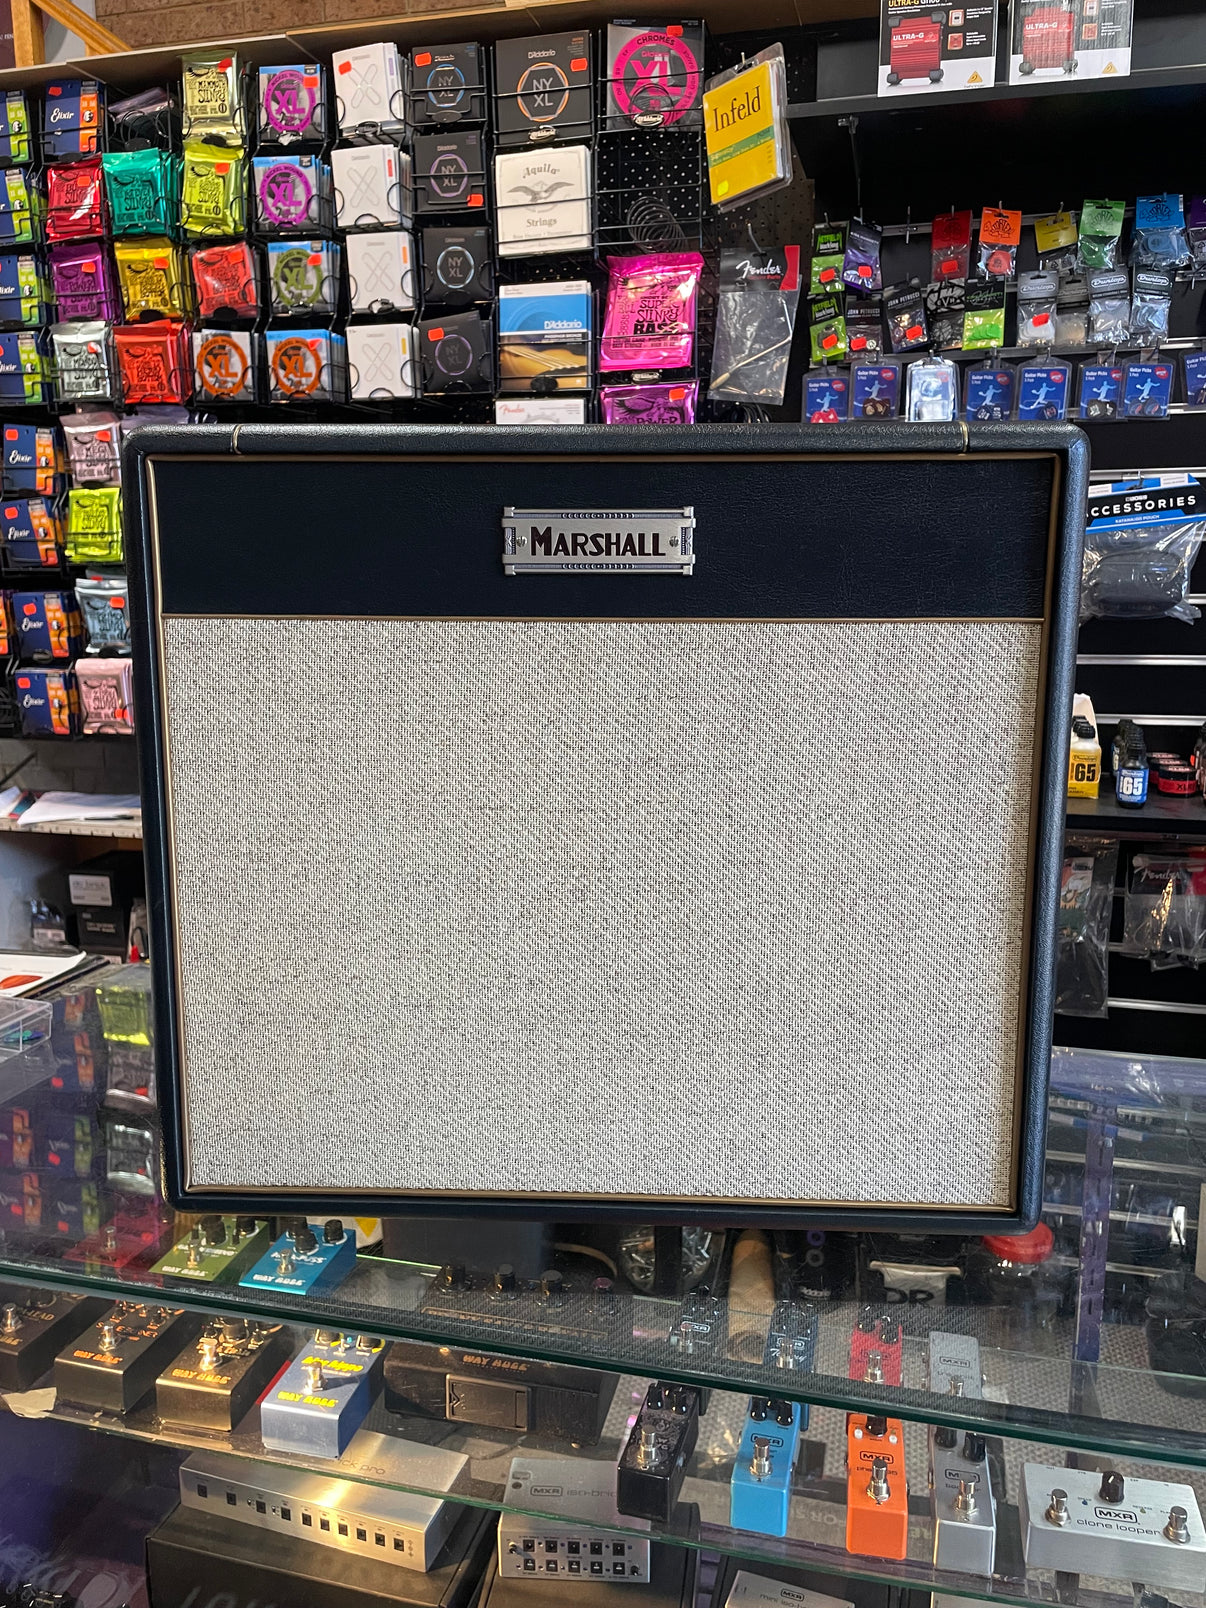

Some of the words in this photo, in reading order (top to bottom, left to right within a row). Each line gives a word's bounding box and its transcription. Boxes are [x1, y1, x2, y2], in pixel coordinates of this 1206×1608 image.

[1025, 22, 1058, 31] ULTRA-G
[636, 35, 676, 46] CHROMES
[893, 32, 925, 41] ULTRA-G
[438, 76, 454, 87] NY
[532, 77, 554, 91] NY
[274, 90, 306, 115] XL
[534, 93, 554, 107] XL
[50, 107, 75, 123] Elixir
[714, 85, 762, 133] Infeld
[523, 163, 558, 179] Aquila
[443, 177, 458, 187] XL
[270, 182, 303, 208] XL
[526, 217, 557, 229] Strings
[448, 257, 463, 267] NY
[735, 258, 782, 279] Fender
[283, 267, 314, 291] XL
[449, 267, 464, 278] XL
[1138, 274, 1169, 285] Dunlop
[1093, 276, 1125, 286] Dunlop
[0, 285, 16, 295] lixir
[636, 308, 680, 324] SLINKY
[544, 319, 583, 330] D'Addario
[0, 362, 17, 372] lixir
[207, 355, 238, 378] XL
[282, 355, 313, 378] XL
[1086, 495, 1197, 517] CCESSORIES
[530, 526, 667, 557] MARSHALL
[1074, 763, 1097, 782] 65
[1122, 777, 1143, 796] 65
[462, 1354, 490, 1366] WAY
[491, 1359, 529, 1371] HUGE
[359, 1464, 386, 1475] pro
[533, 1487, 561, 1495] MXR
[566, 1489, 618, 1498] iso-bric
[1098, 1509, 1134, 1521] MXR
[1076, 1519, 1113, 1529] clone
[1116, 1523, 1161, 1536] looper
